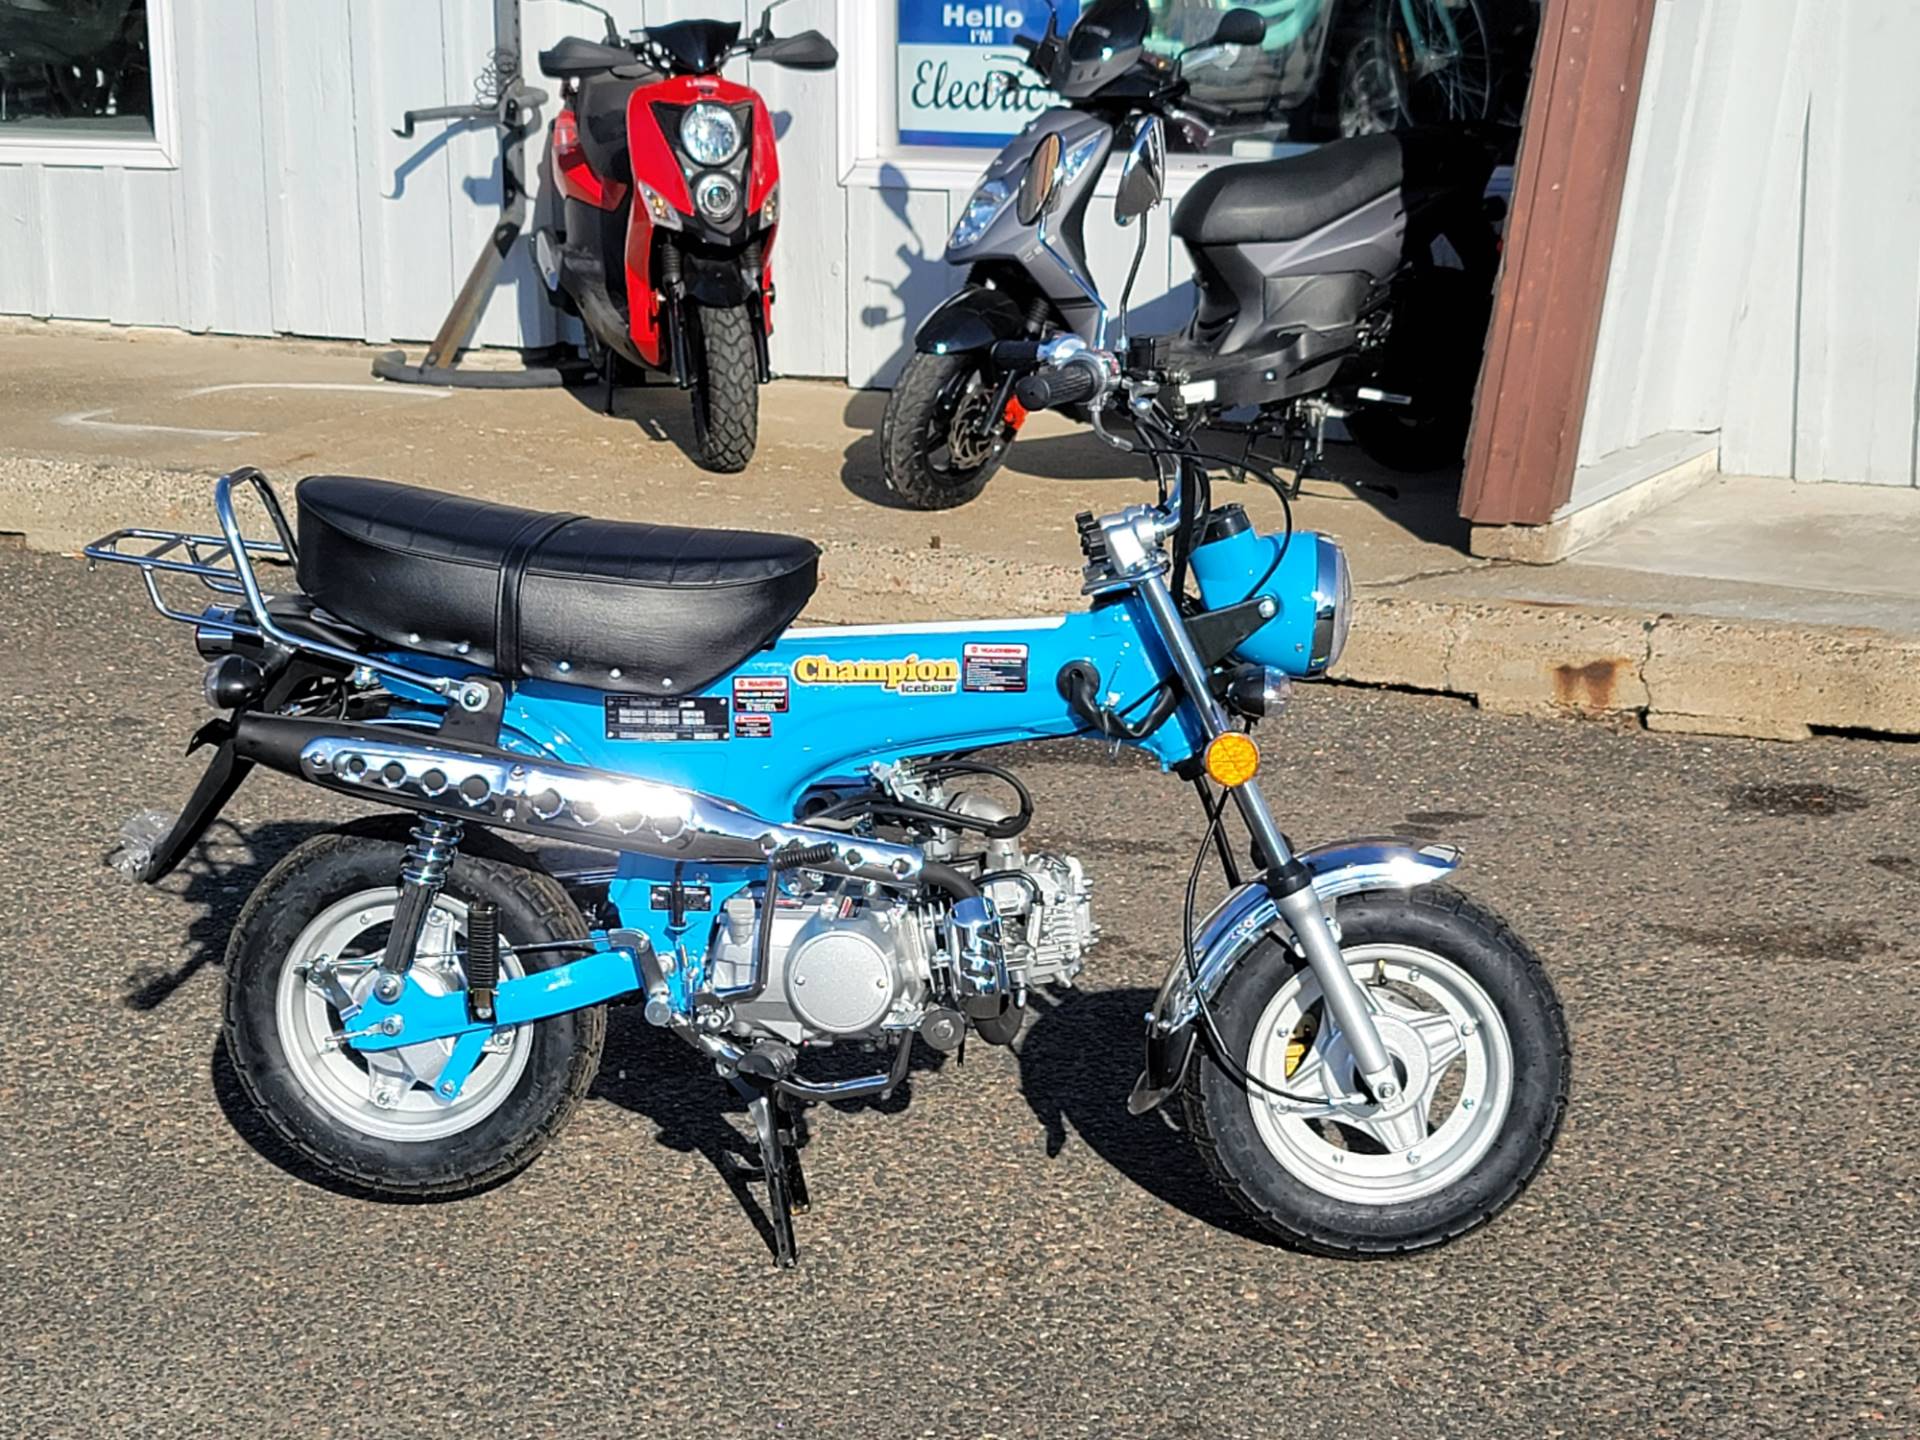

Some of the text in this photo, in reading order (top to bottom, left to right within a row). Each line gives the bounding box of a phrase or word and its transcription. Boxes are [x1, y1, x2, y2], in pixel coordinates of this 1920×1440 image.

[943, 4, 1024, 28] Hello
[970, 29, 993, 44] I'M
[795, 656, 958, 690] Champion
